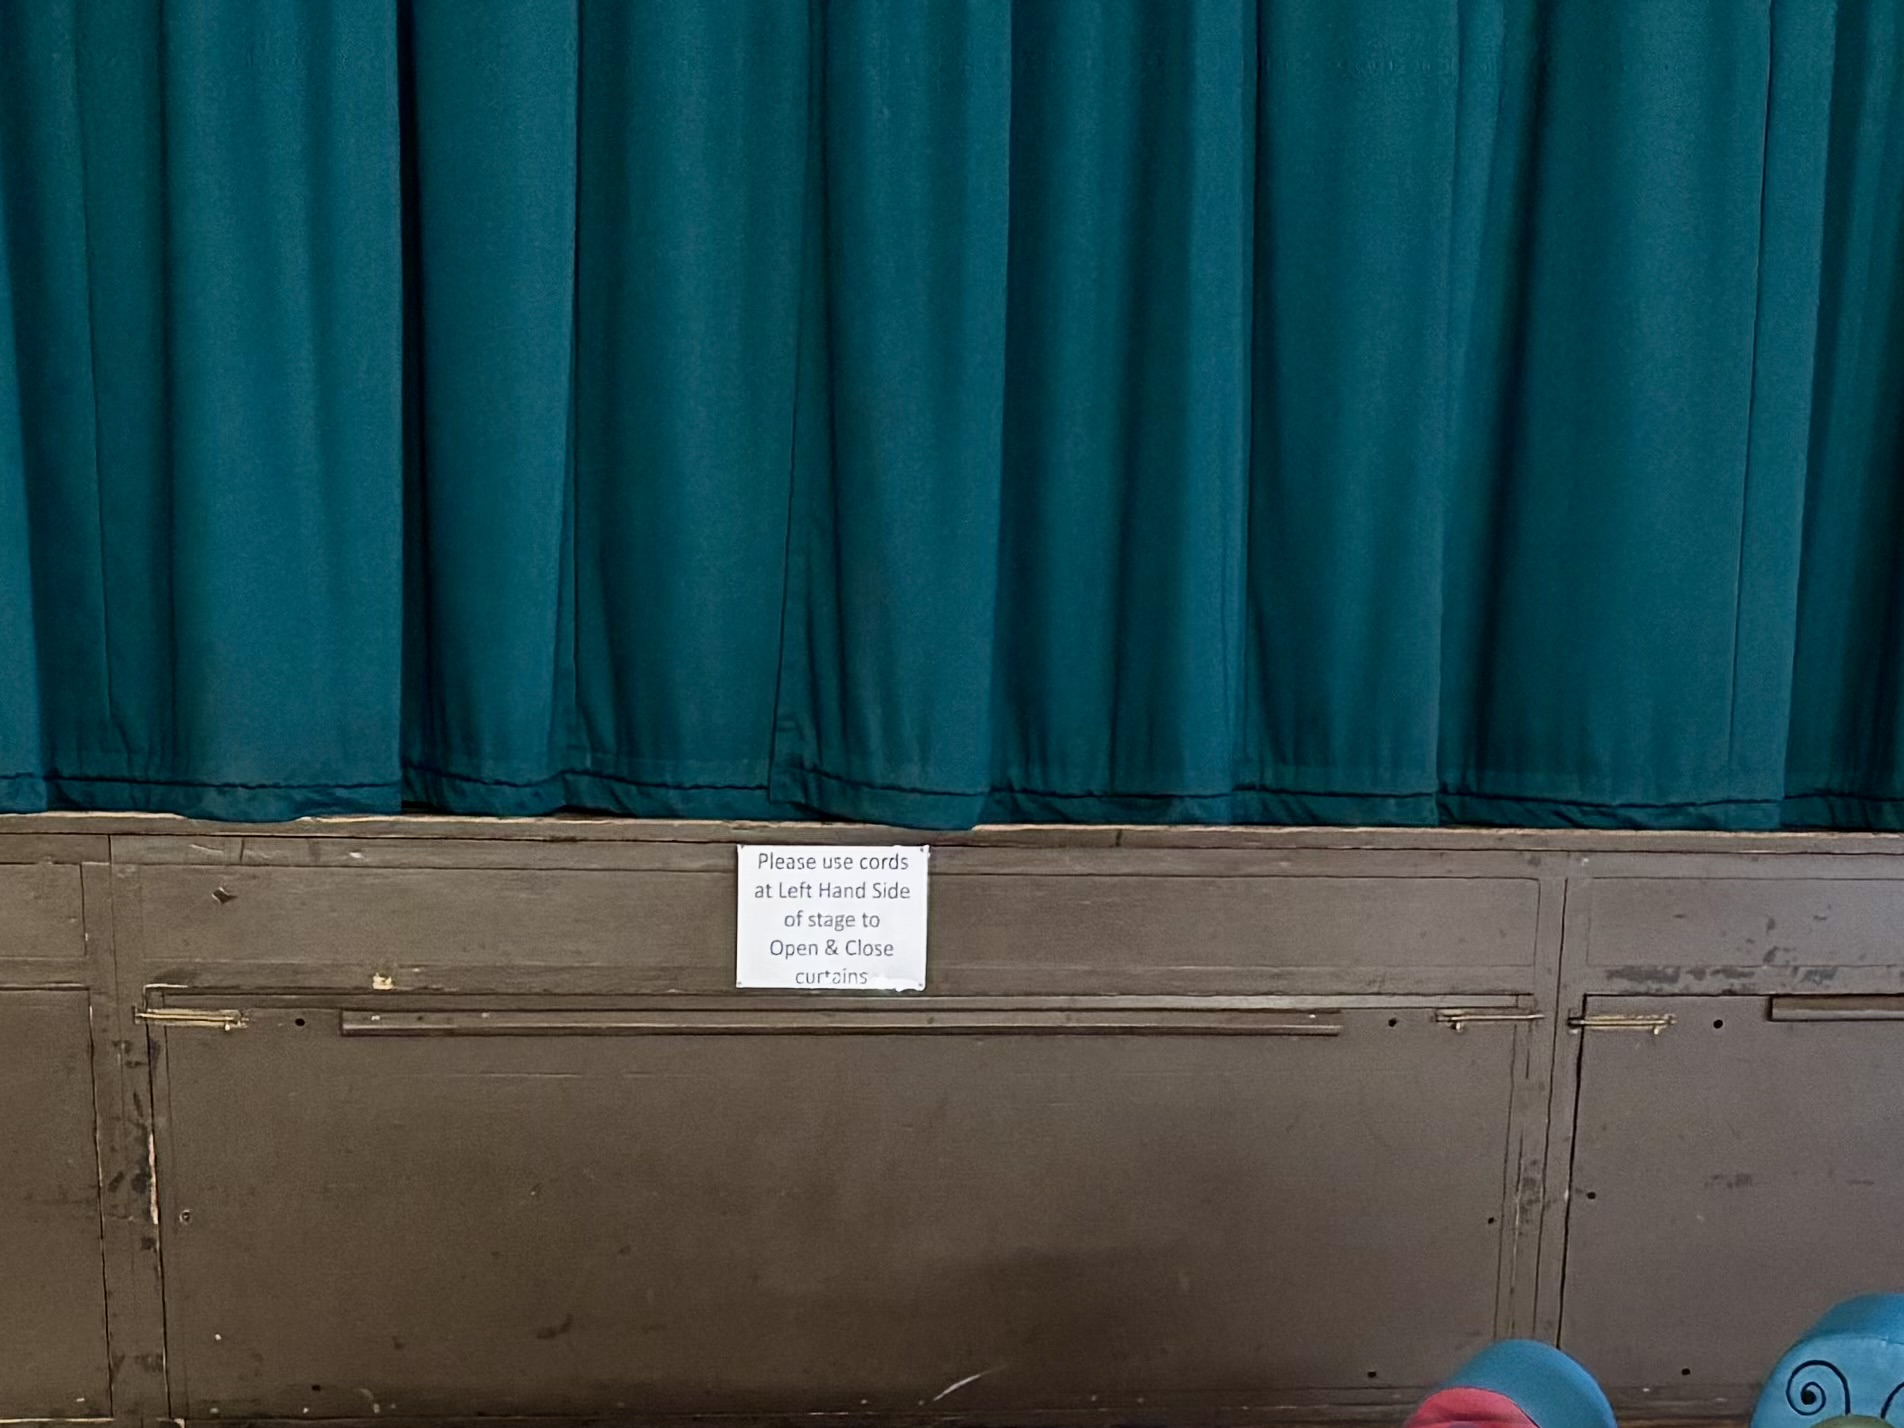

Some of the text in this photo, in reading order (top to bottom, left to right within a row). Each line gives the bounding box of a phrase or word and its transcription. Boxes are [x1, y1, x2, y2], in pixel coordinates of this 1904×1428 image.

[758, 852, 909, 870] Please use cords
[754, 881, 911, 899] at Left Hand Side
[784, 910, 880, 931] of stage to
[770, 939, 894, 959] Open & Close
